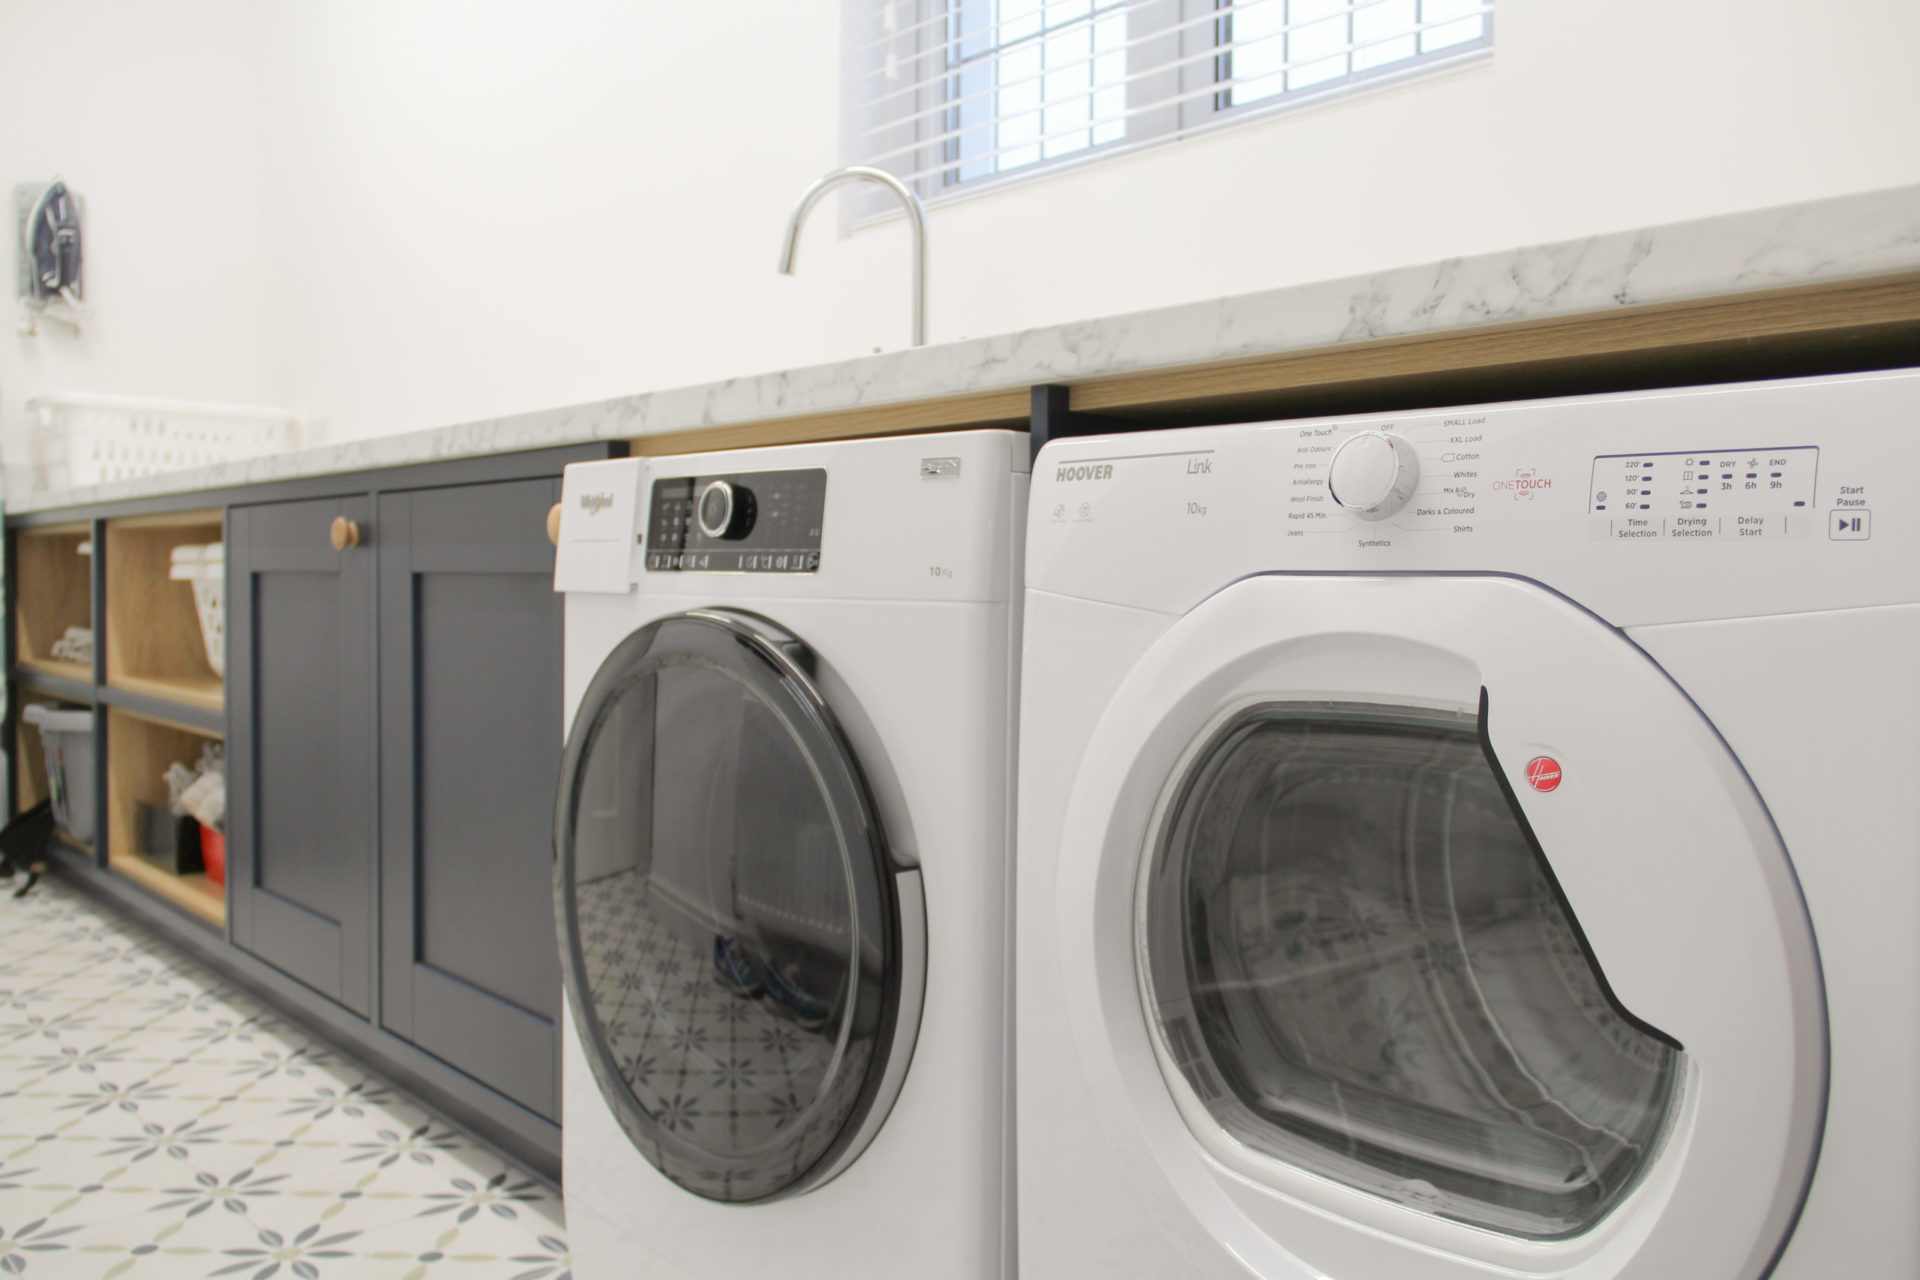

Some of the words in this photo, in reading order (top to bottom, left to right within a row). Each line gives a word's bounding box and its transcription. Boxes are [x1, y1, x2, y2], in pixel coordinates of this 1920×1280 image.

[1443, 419, 1466, 427] SMALL
[1468, 417, 1486, 425] Load
[1381, 424, 1395, 432] OFF
[1187, 459, 1212, 474] Link
[1056, 464, 1113, 482] HOOVER
[1770, 481, 1782, 489] 9h
[1840, 486, 1864, 494] Start
[1463, 491, 1475, 499] Dry
[1837, 498, 1866, 506] Pause
[1416, 508, 1436, 516] Darks
[1443, 507, 1475, 515] Coloured
[1677, 518, 1707, 527] Drying
[1738, 517, 1765, 526] Delay
[1672, 529, 1712, 537] Selection
[1739, 528, 1762, 536] Start
[1358, 540, 1391, 548] Synthetics
